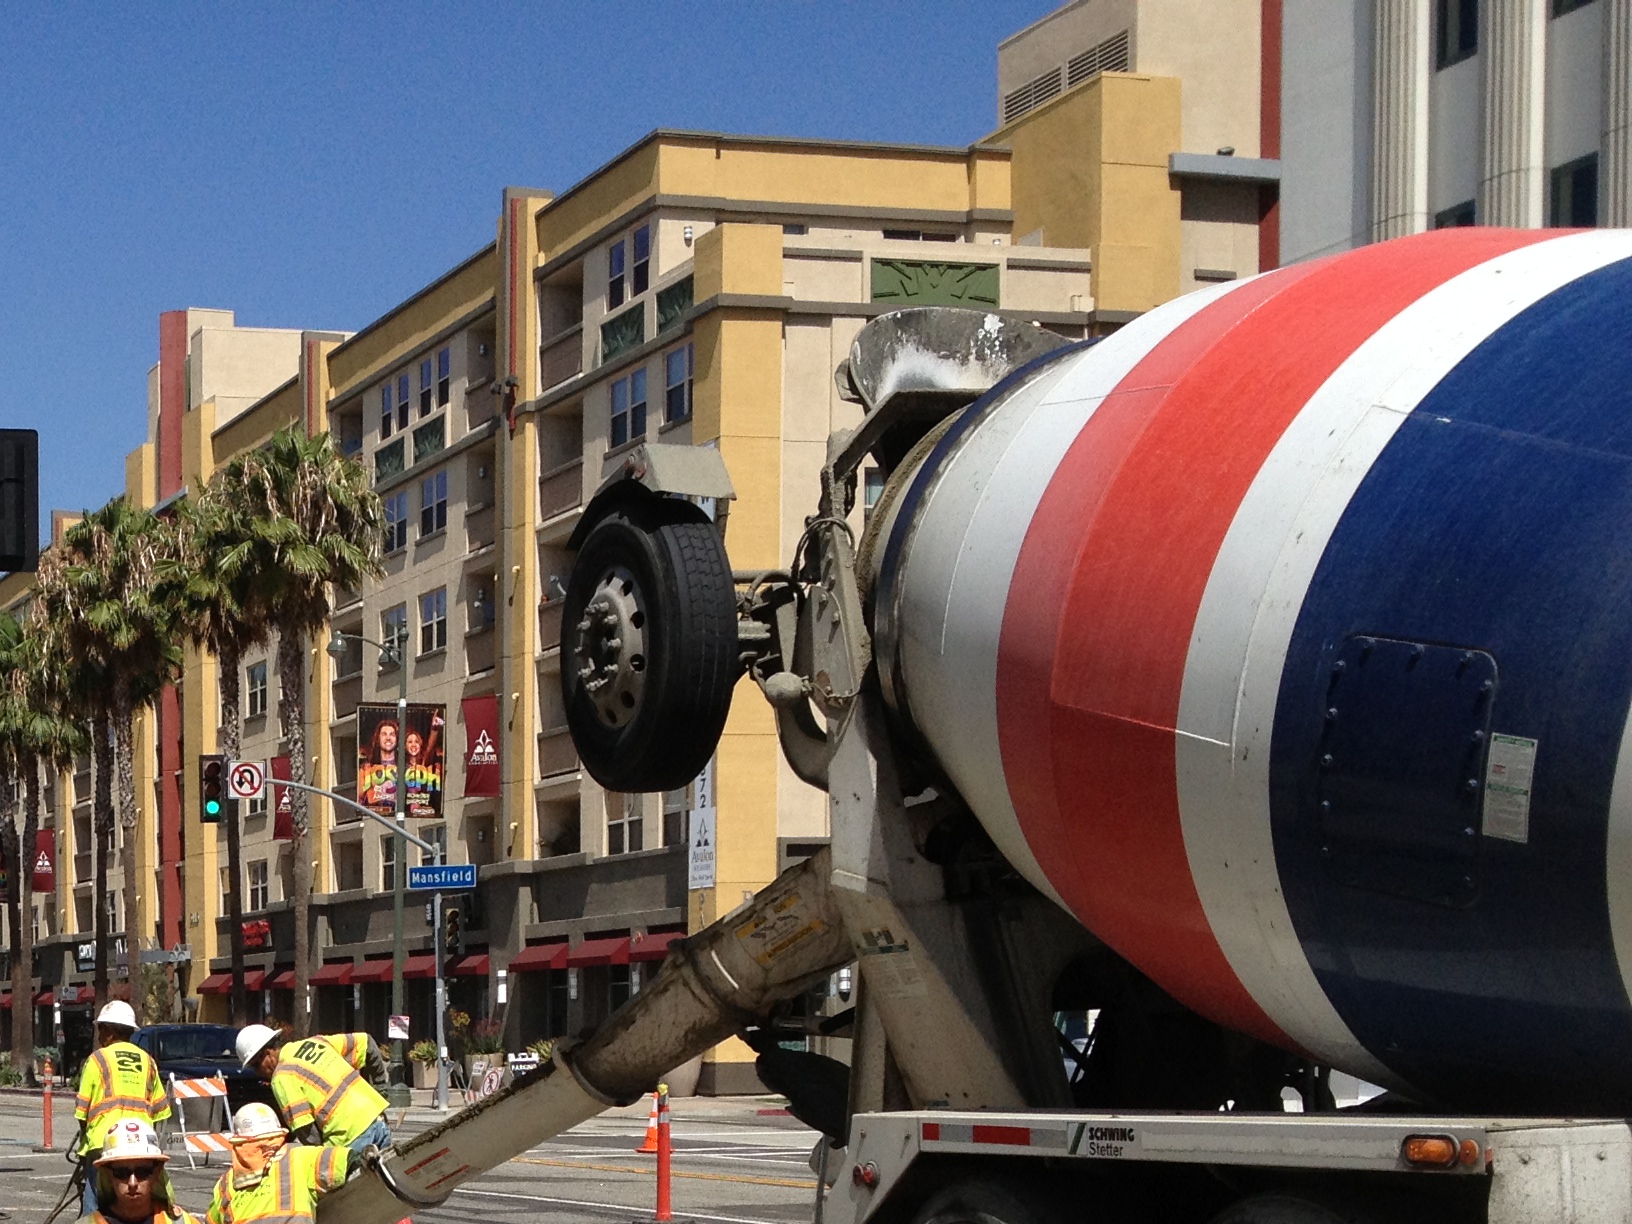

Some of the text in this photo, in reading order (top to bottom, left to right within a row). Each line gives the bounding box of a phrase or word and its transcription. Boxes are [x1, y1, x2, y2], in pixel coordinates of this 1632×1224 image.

[470, 753, 498, 762] Avalon
[411, 870, 472, 884] Mansfield
[1089, 1127, 1135, 1142] SCHWING
[1089, 1142, 1124, 1157] Stetter
